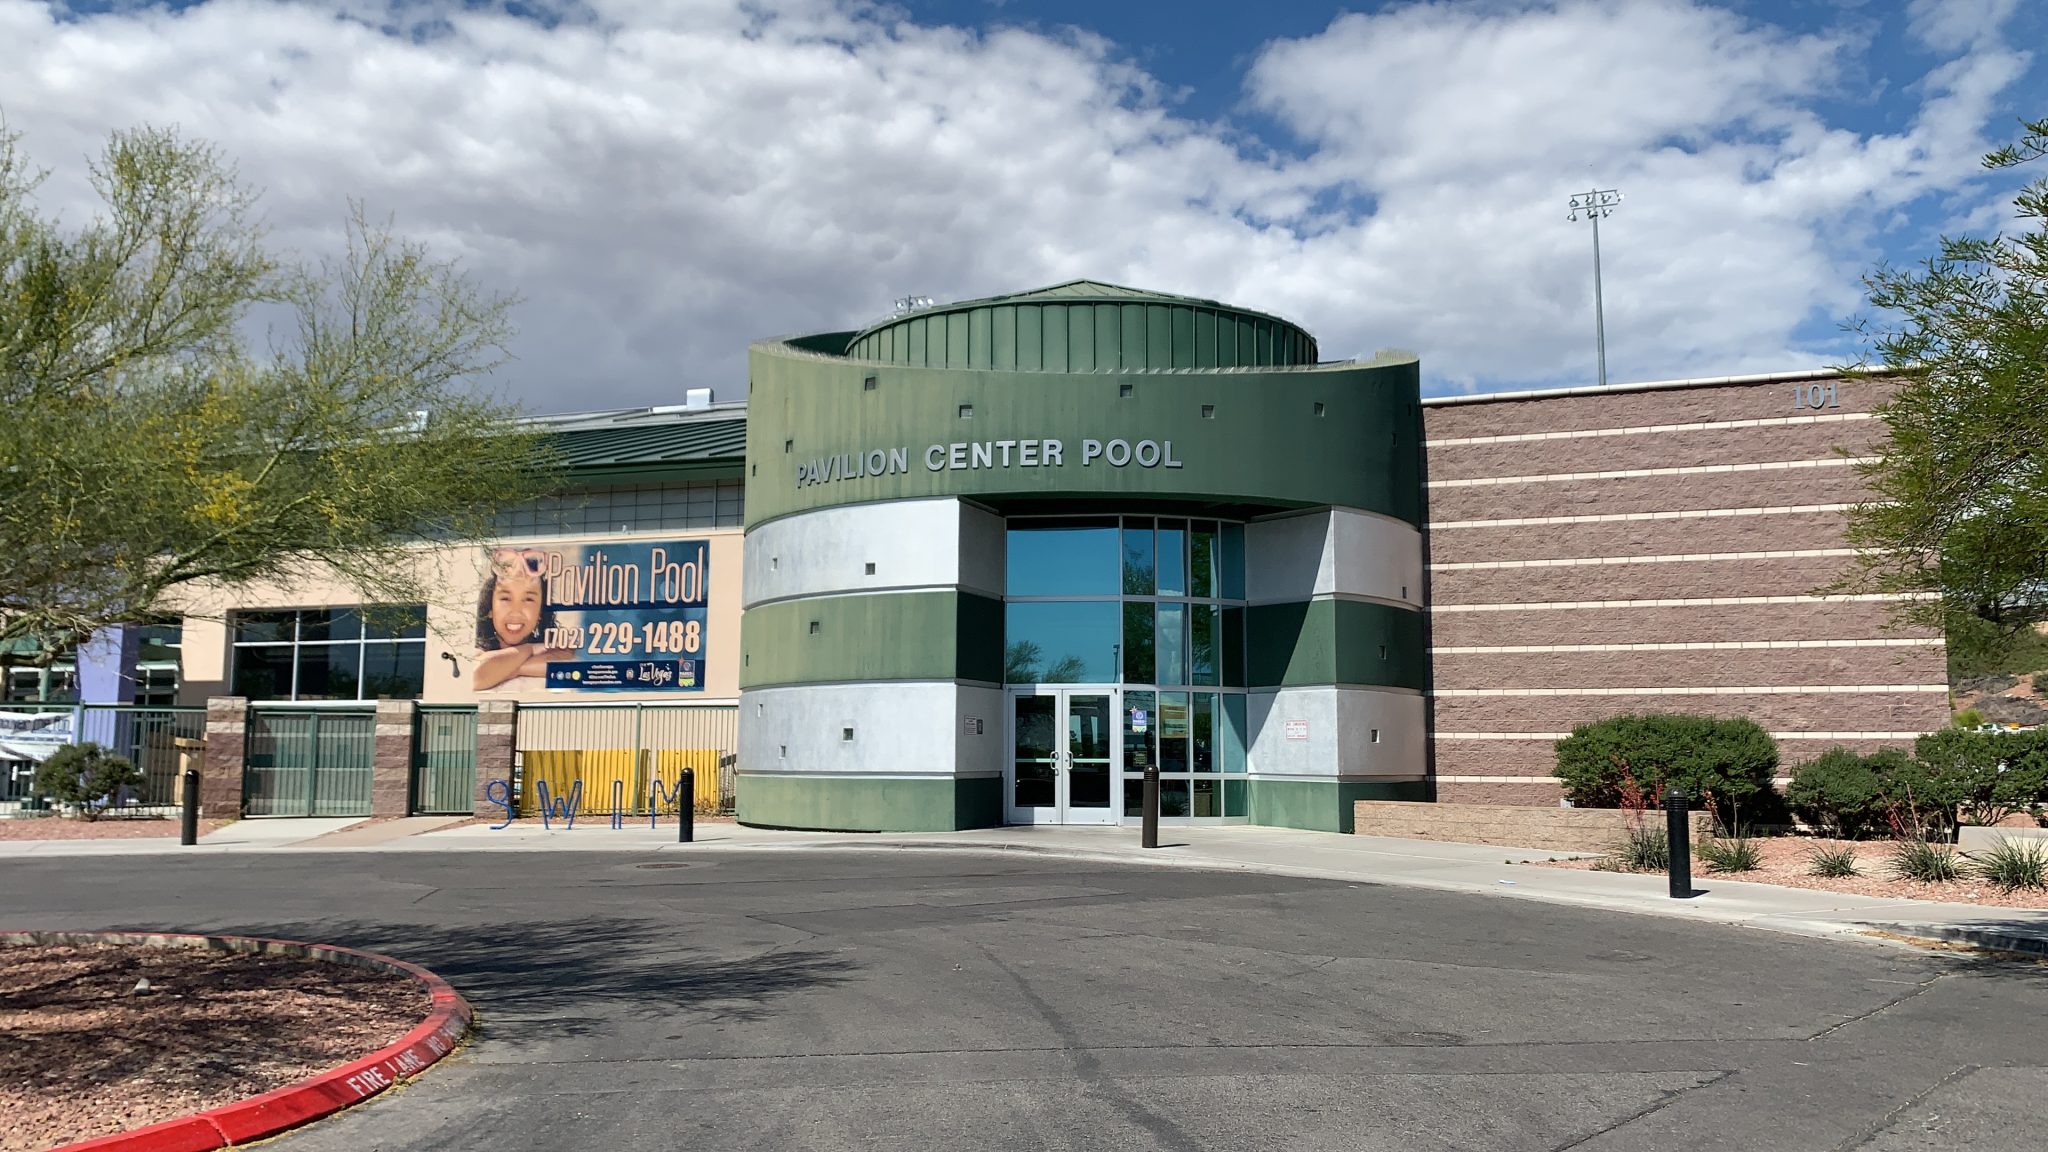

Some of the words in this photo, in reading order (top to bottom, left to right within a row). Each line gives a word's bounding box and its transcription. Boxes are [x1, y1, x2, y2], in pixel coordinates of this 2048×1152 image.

[1793, 384, 1840, 409] 101
[796, 447, 908, 488] PAVILION
[925, 439, 1064, 471] CENTER
[1082, 439, 1183, 468] POOL
[546, 549, 640, 607] Pavilion
[650, 546, 703, 604] Pool
[545, 627, 584, 649] (702)
[588, 621, 700, 654] 229-1488
[346, 1066, 391, 1097] FIRE
